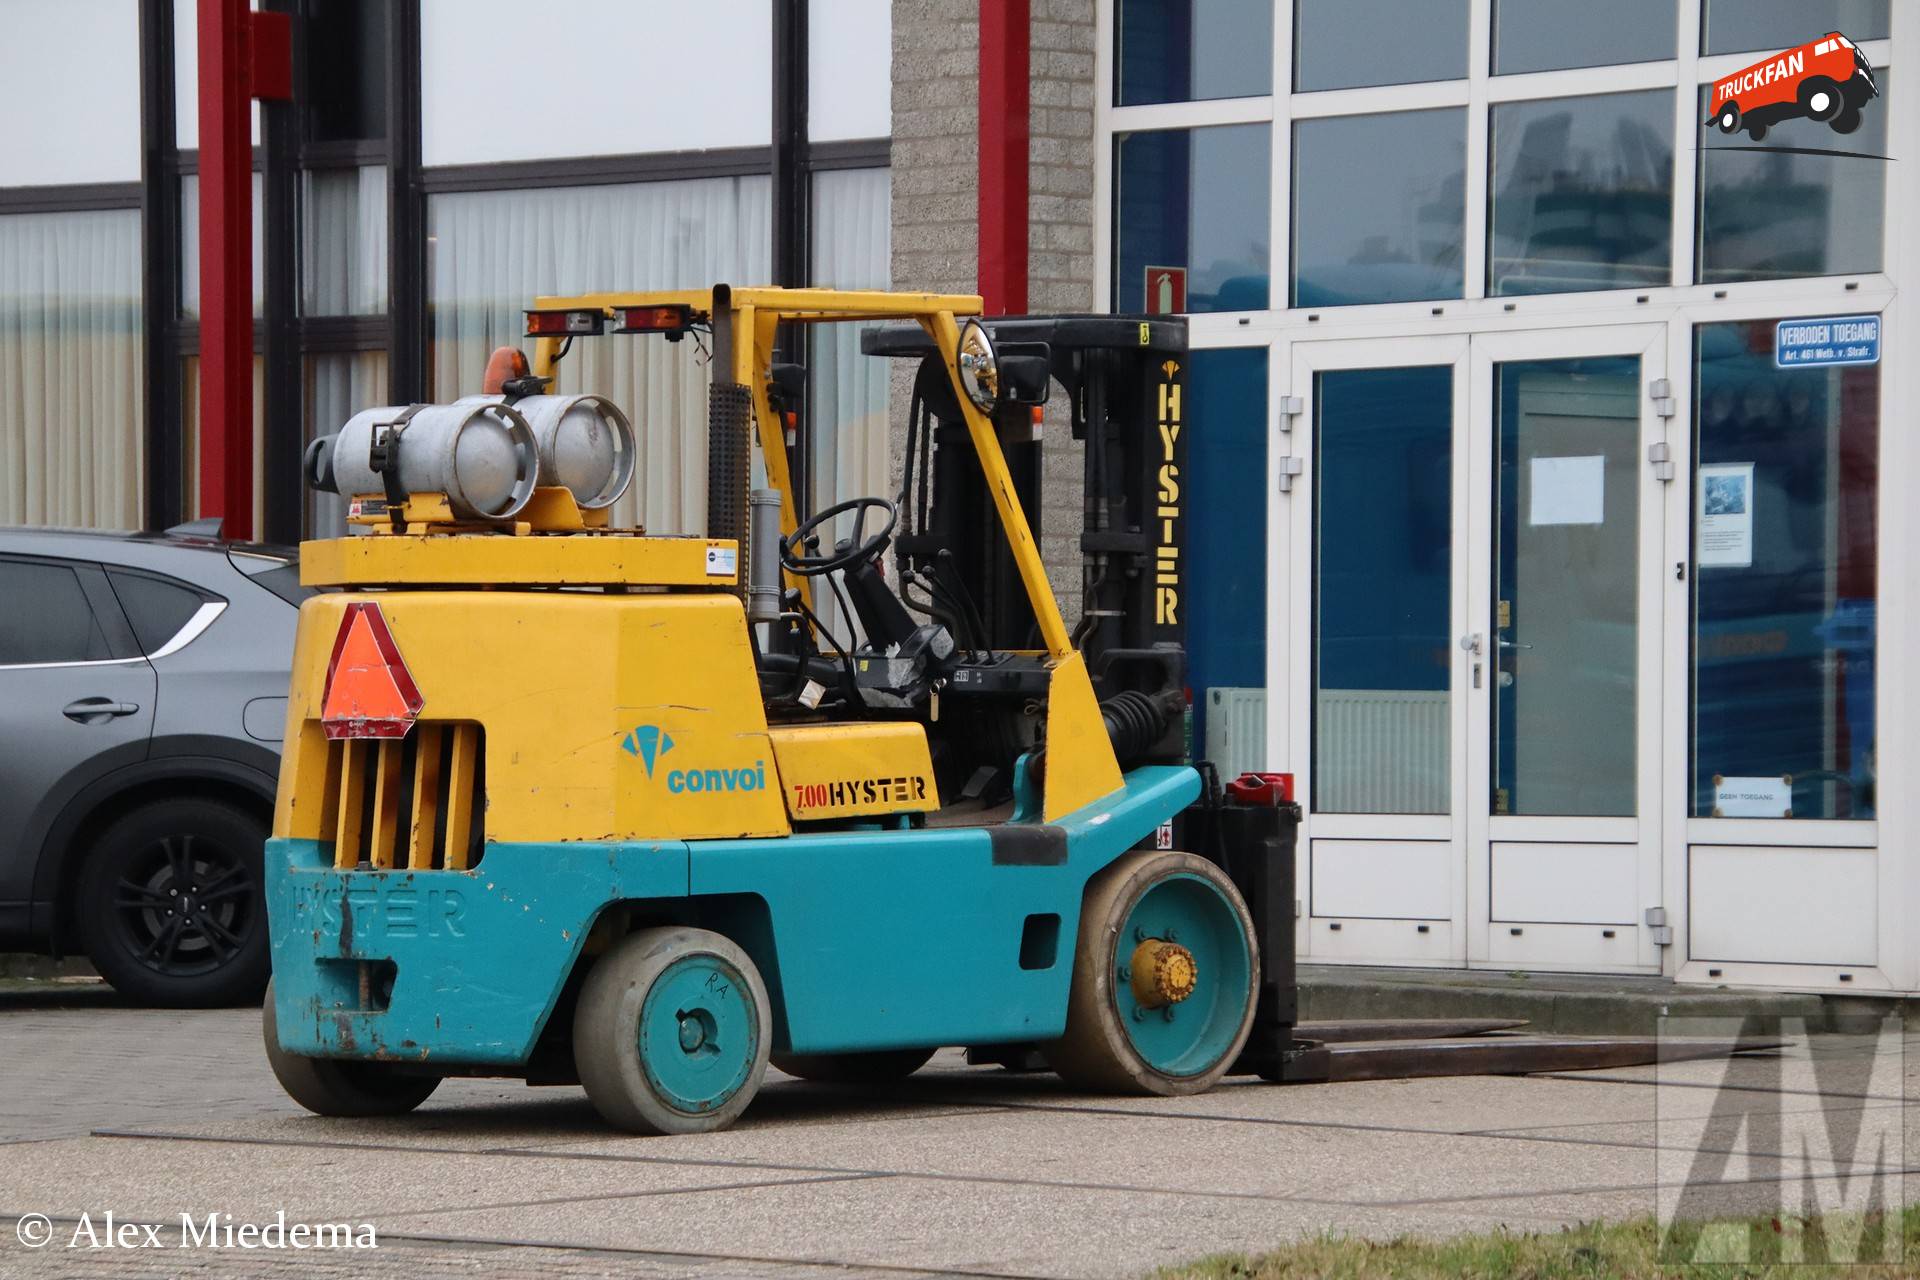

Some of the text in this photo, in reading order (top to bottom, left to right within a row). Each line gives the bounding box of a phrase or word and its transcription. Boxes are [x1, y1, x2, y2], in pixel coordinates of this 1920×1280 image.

[1781, 322, 1877, 345] VERBODEN TOEGANG
[1785, 350, 1799, 361] Art.
[1801, 349, 1814, 359] 461
[1156, 383, 1182, 625] HYSTER
[667, 760, 765, 794] convoi
[829, 776, 926, 807] HYSTER
